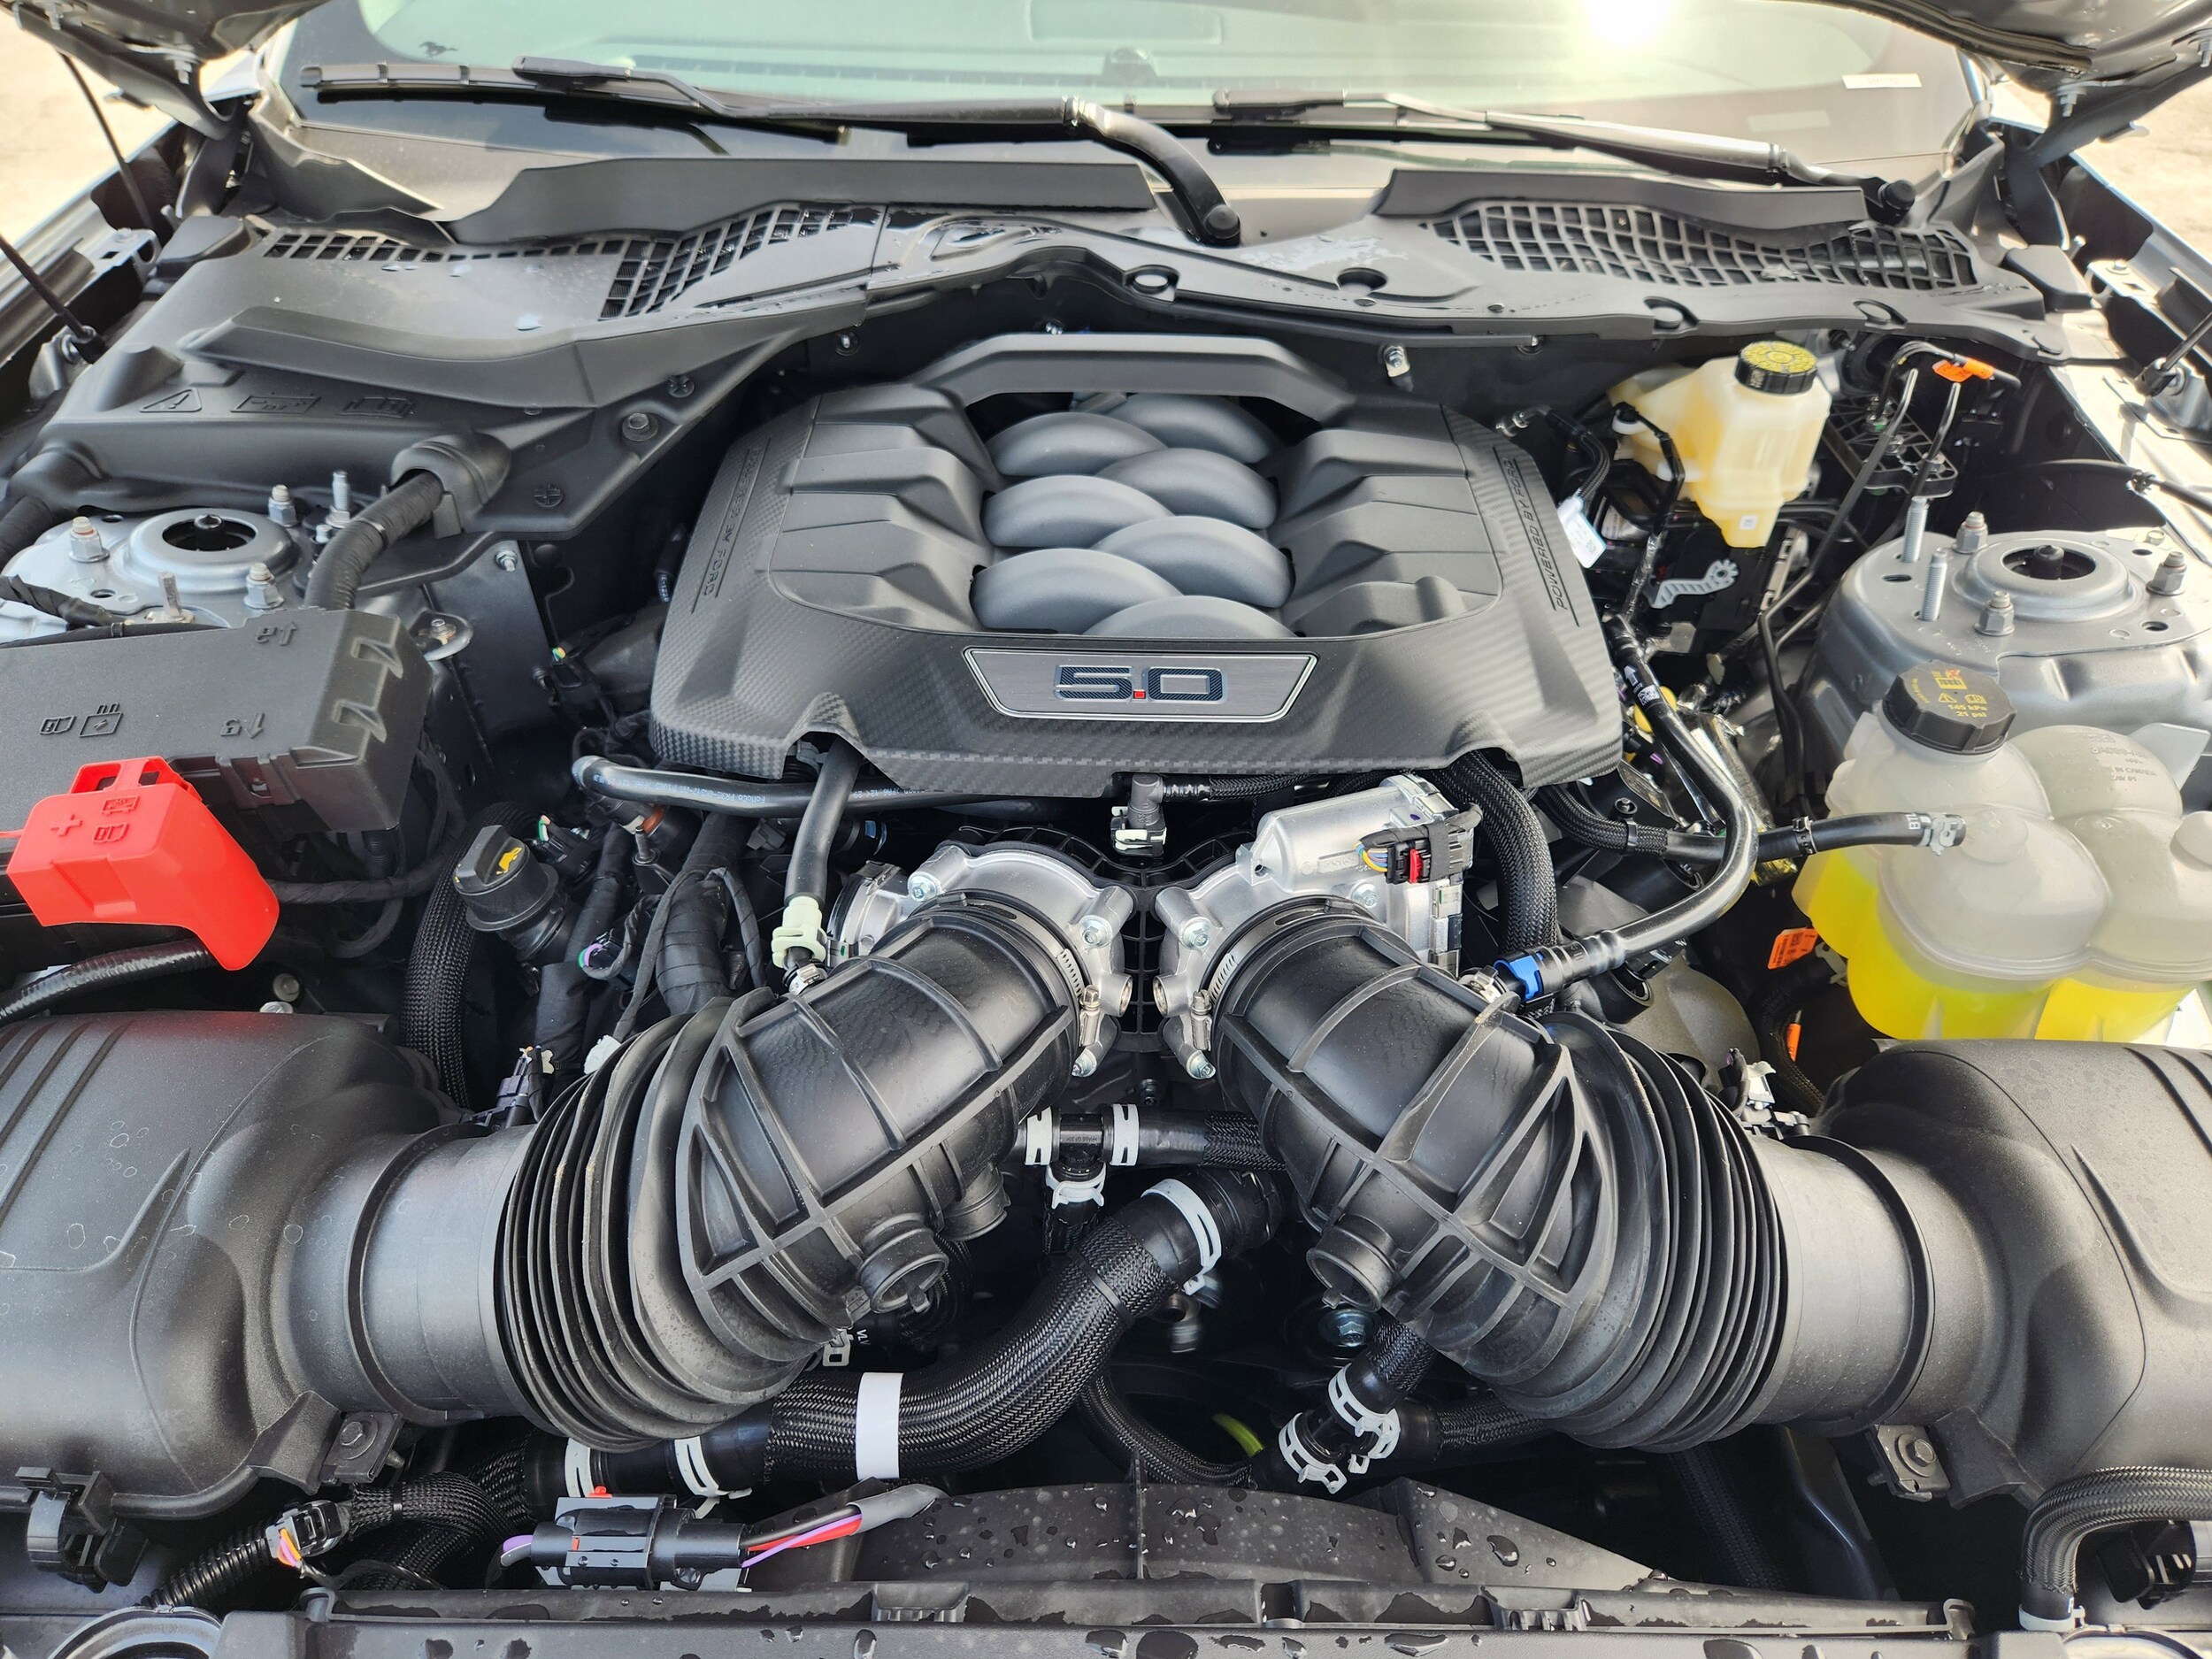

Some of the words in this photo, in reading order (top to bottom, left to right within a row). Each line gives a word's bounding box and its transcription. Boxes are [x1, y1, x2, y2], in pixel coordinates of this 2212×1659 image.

[1503, 459, 1525, 497] FORD
[1519, 501, 1534, 522] BY
[703, 549, 726, 595] FORD
[1528, 526, 1568, 611] POWERED
[1055, 665, 1227, 703] 5.0
